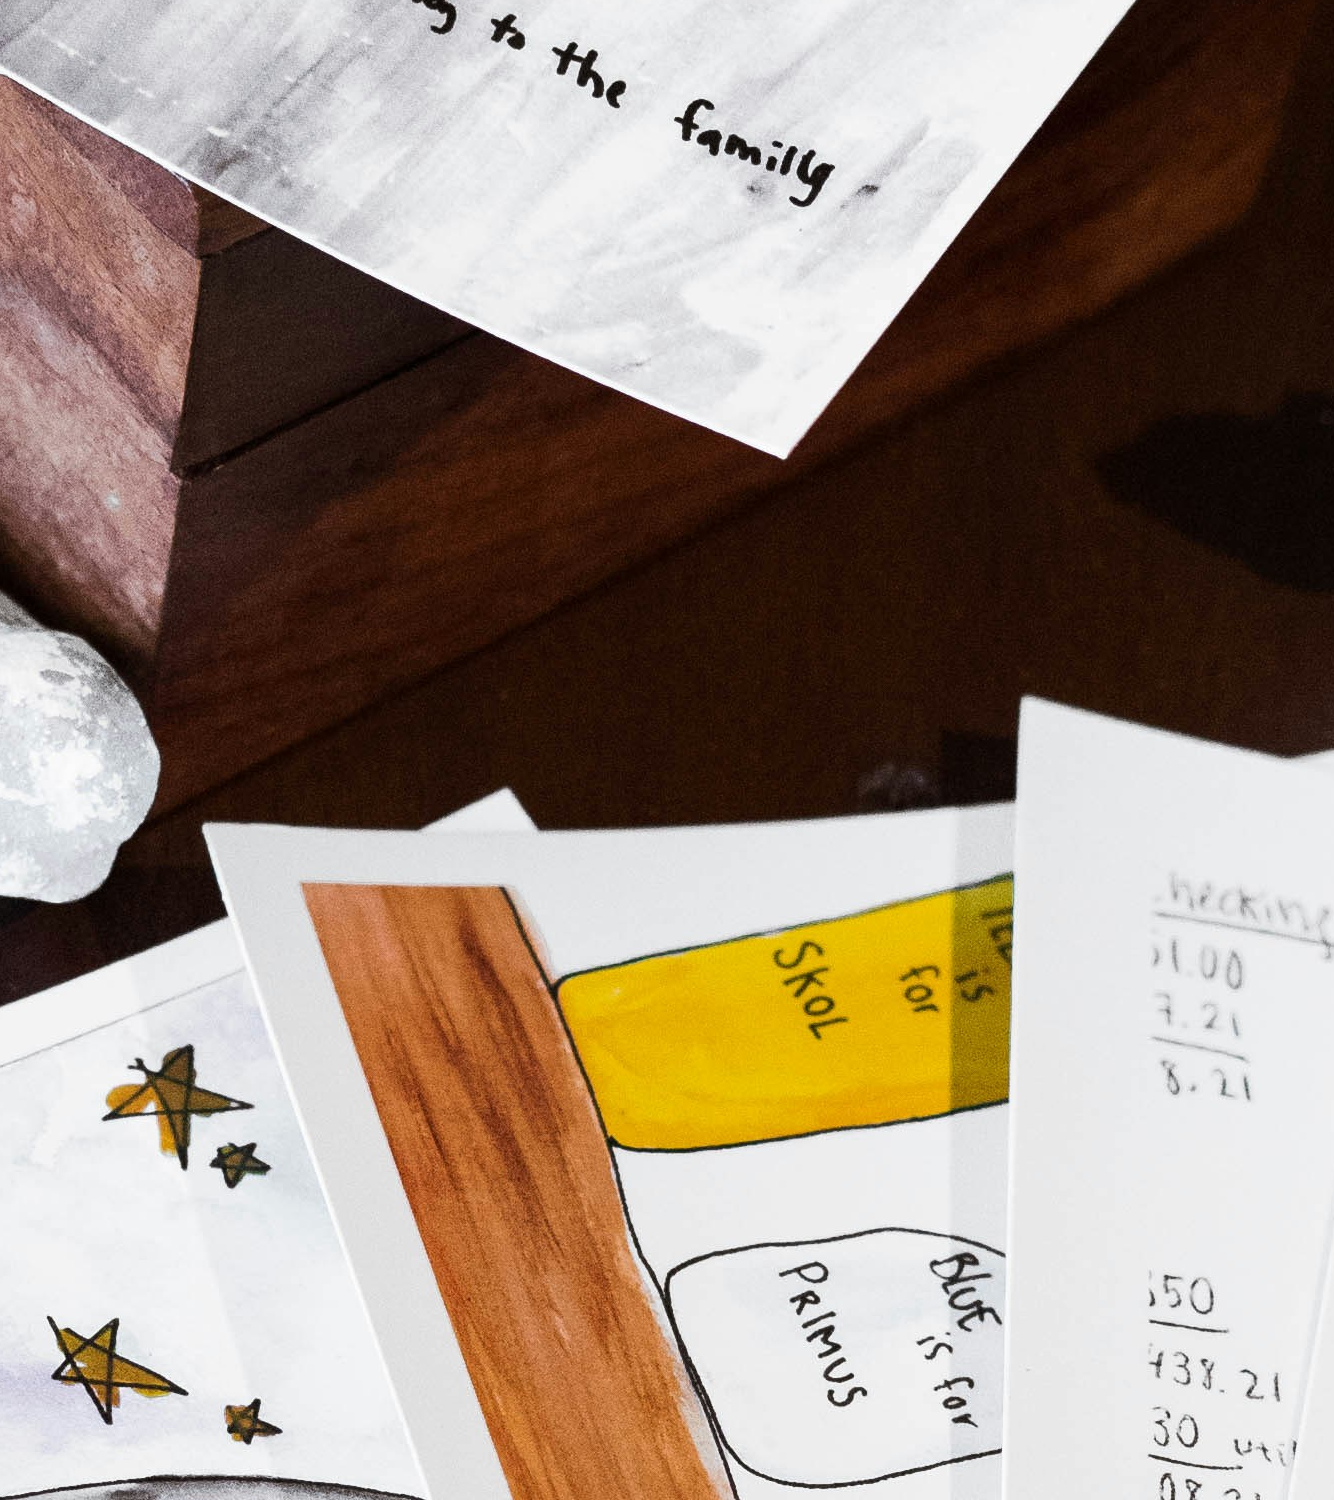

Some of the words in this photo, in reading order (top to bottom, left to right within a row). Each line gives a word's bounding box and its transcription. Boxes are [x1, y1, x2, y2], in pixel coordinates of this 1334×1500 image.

[490, 13, 527, 50] to
[551, 41, 628, 110] the
[674, 98, 836, 208] family
[1155, 871, 1333, 960] hecking
[773, 940, 850, 1041] SKOL
[898, 964, 941, 1014] for
[954, 966, 996, 1003] is
[1161, 1059, 1252, 1102] 8.21
[929, 1252, 1004, 1334] BLUE
[778, 1260, 868, 1408] PRIMUS
[916, 1330, 954, 1361] is
[933, 1375, 980, 1430] for
[1152, 1406, 1199, 1449] 30
